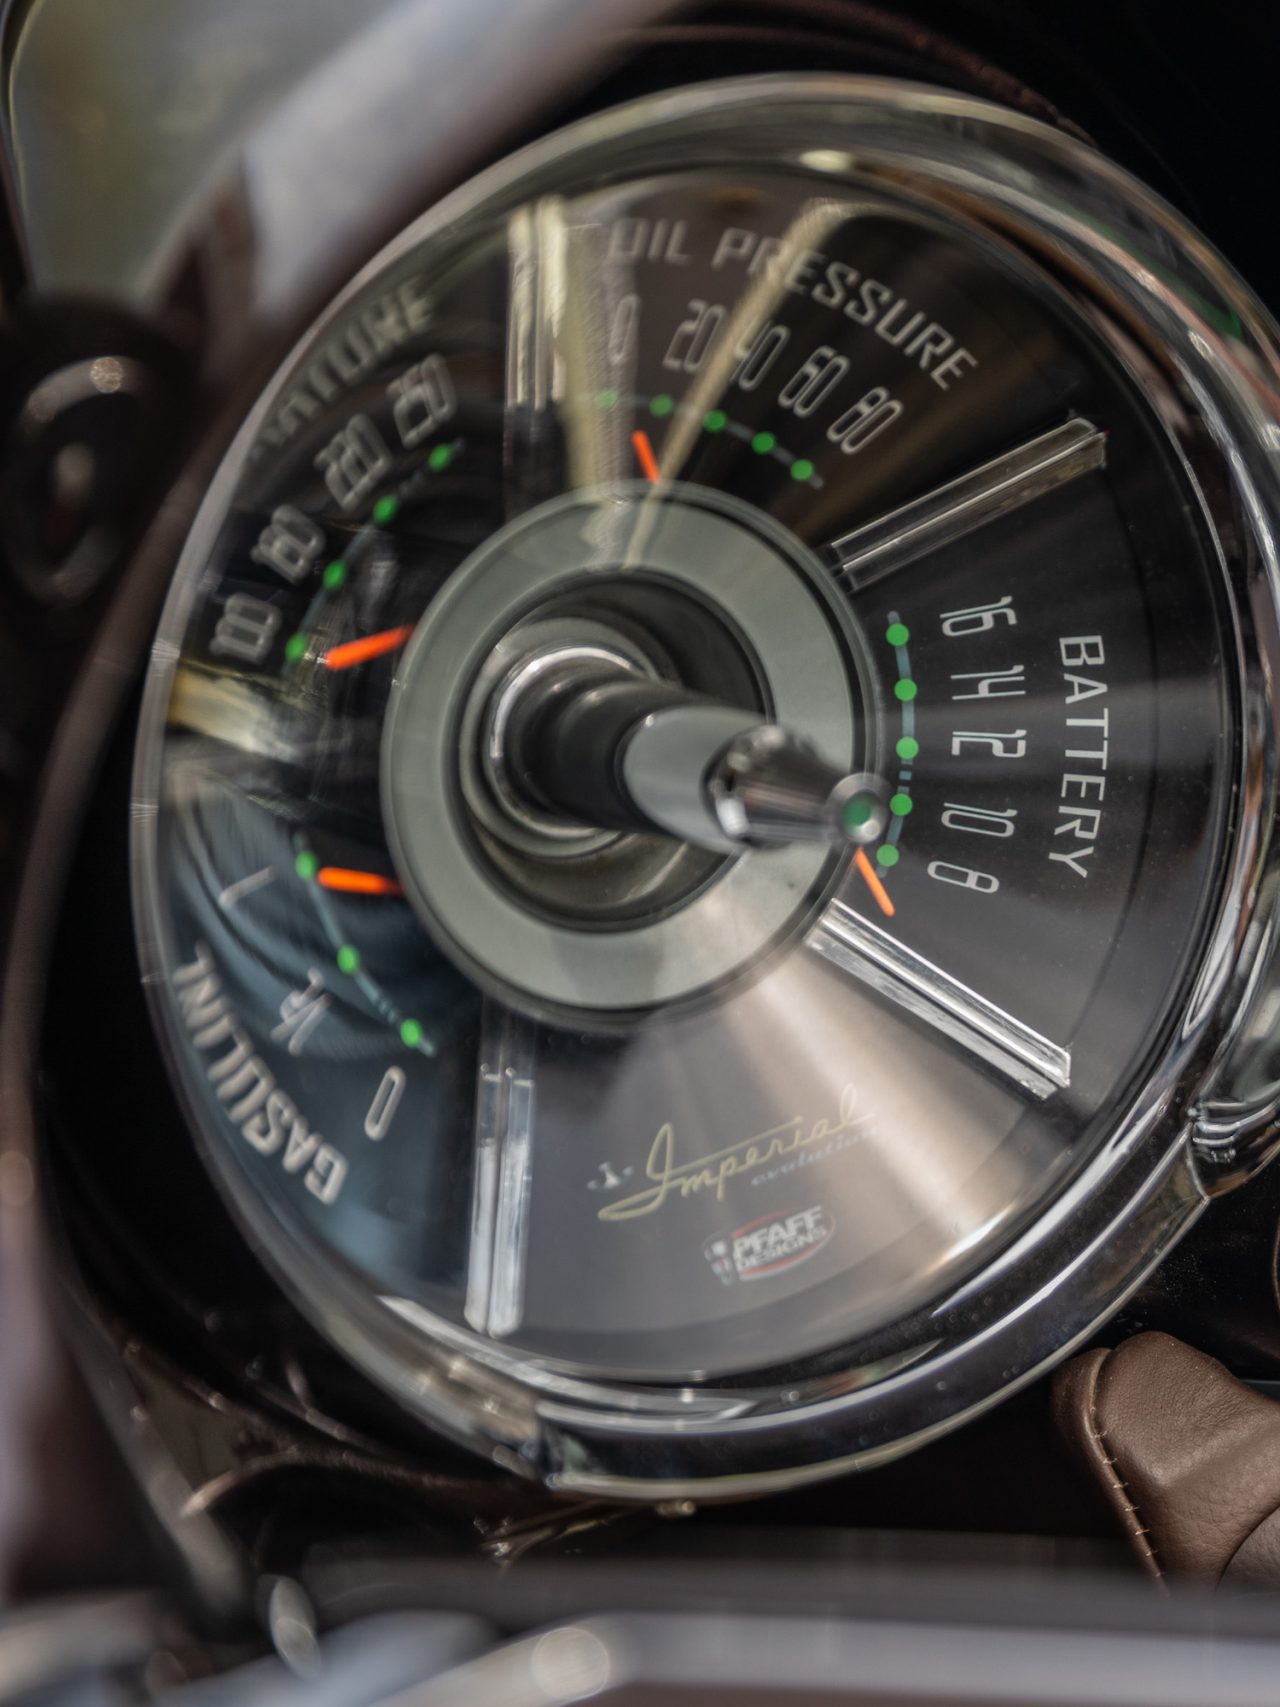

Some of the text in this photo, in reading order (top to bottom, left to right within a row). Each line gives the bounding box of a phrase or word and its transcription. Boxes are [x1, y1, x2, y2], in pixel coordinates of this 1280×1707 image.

[608, 217, 979, 391] OIL PRESSURE
[608, 293, 640, 366] 0
[662, 298, 726, 373] 20
[777, 345, 850, 417] 60
[826, 386, 903, 454] 80
[314, 413, 393, 510] 220
[251, 505, 326, 584] 180
[940, 596, 1017, 637] 16
[951, 665, 1026, 700] 14
[952, 729, 1027, 758] 12
[1048, 635, 1108, 878] BATTERY
[941, 802, 1018, 838] 10
[927, 860, 999, 894] 8
[172, 941, 348, 1205] GASOLINE
[364, 1065, 406, 1141] 0
[598, 1084, 876, 1221] Imperial
[733, 1205, 823, 1259] PFAFF
[737, 1226, 828, 1272] DESIGNS
